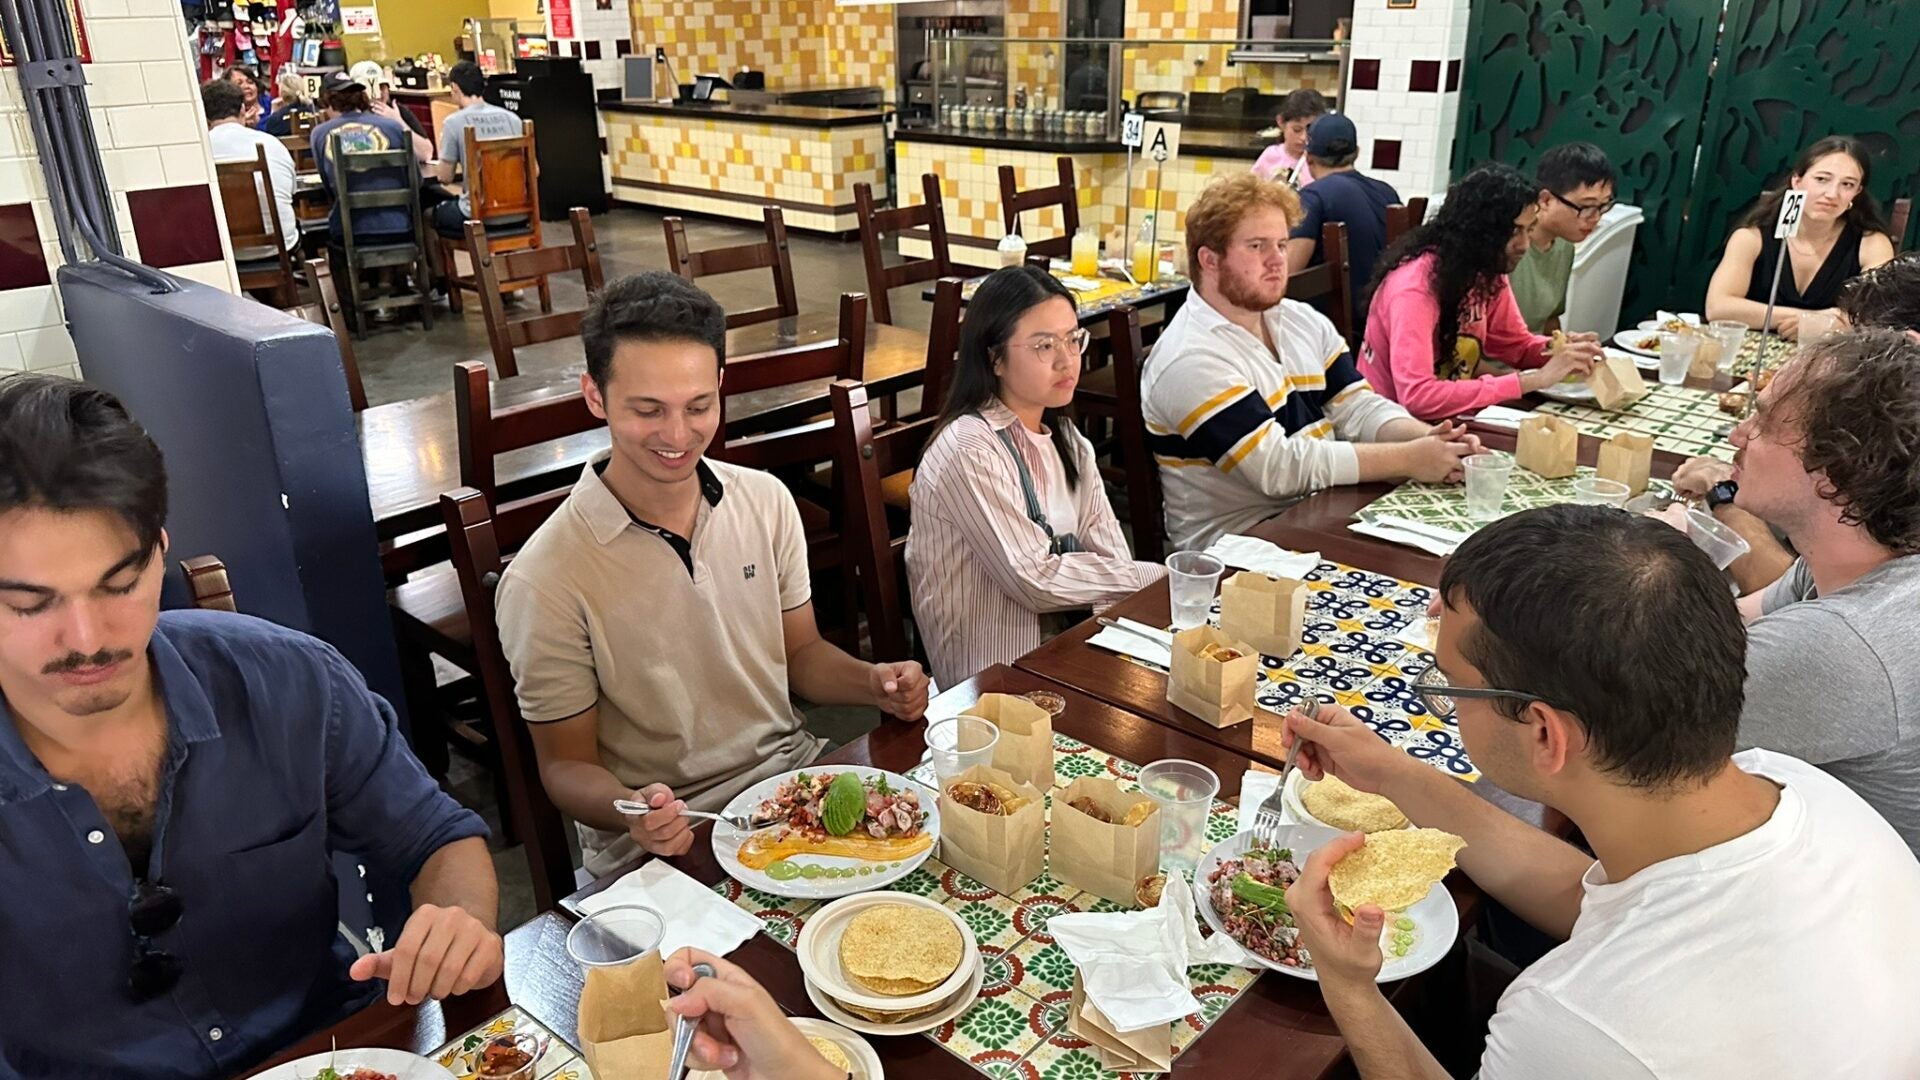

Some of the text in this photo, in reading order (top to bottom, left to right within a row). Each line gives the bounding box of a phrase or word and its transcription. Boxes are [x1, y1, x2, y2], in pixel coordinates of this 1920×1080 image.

[307, 79, 316, 92] B
[499, 89, 521, 100] THANK
[504, 101, 519, 111] YOU
[1126, 119, 1139, 141] 34
[1150, 127, 1167, 151] A
[1782, 194, 1803, 225] 25
